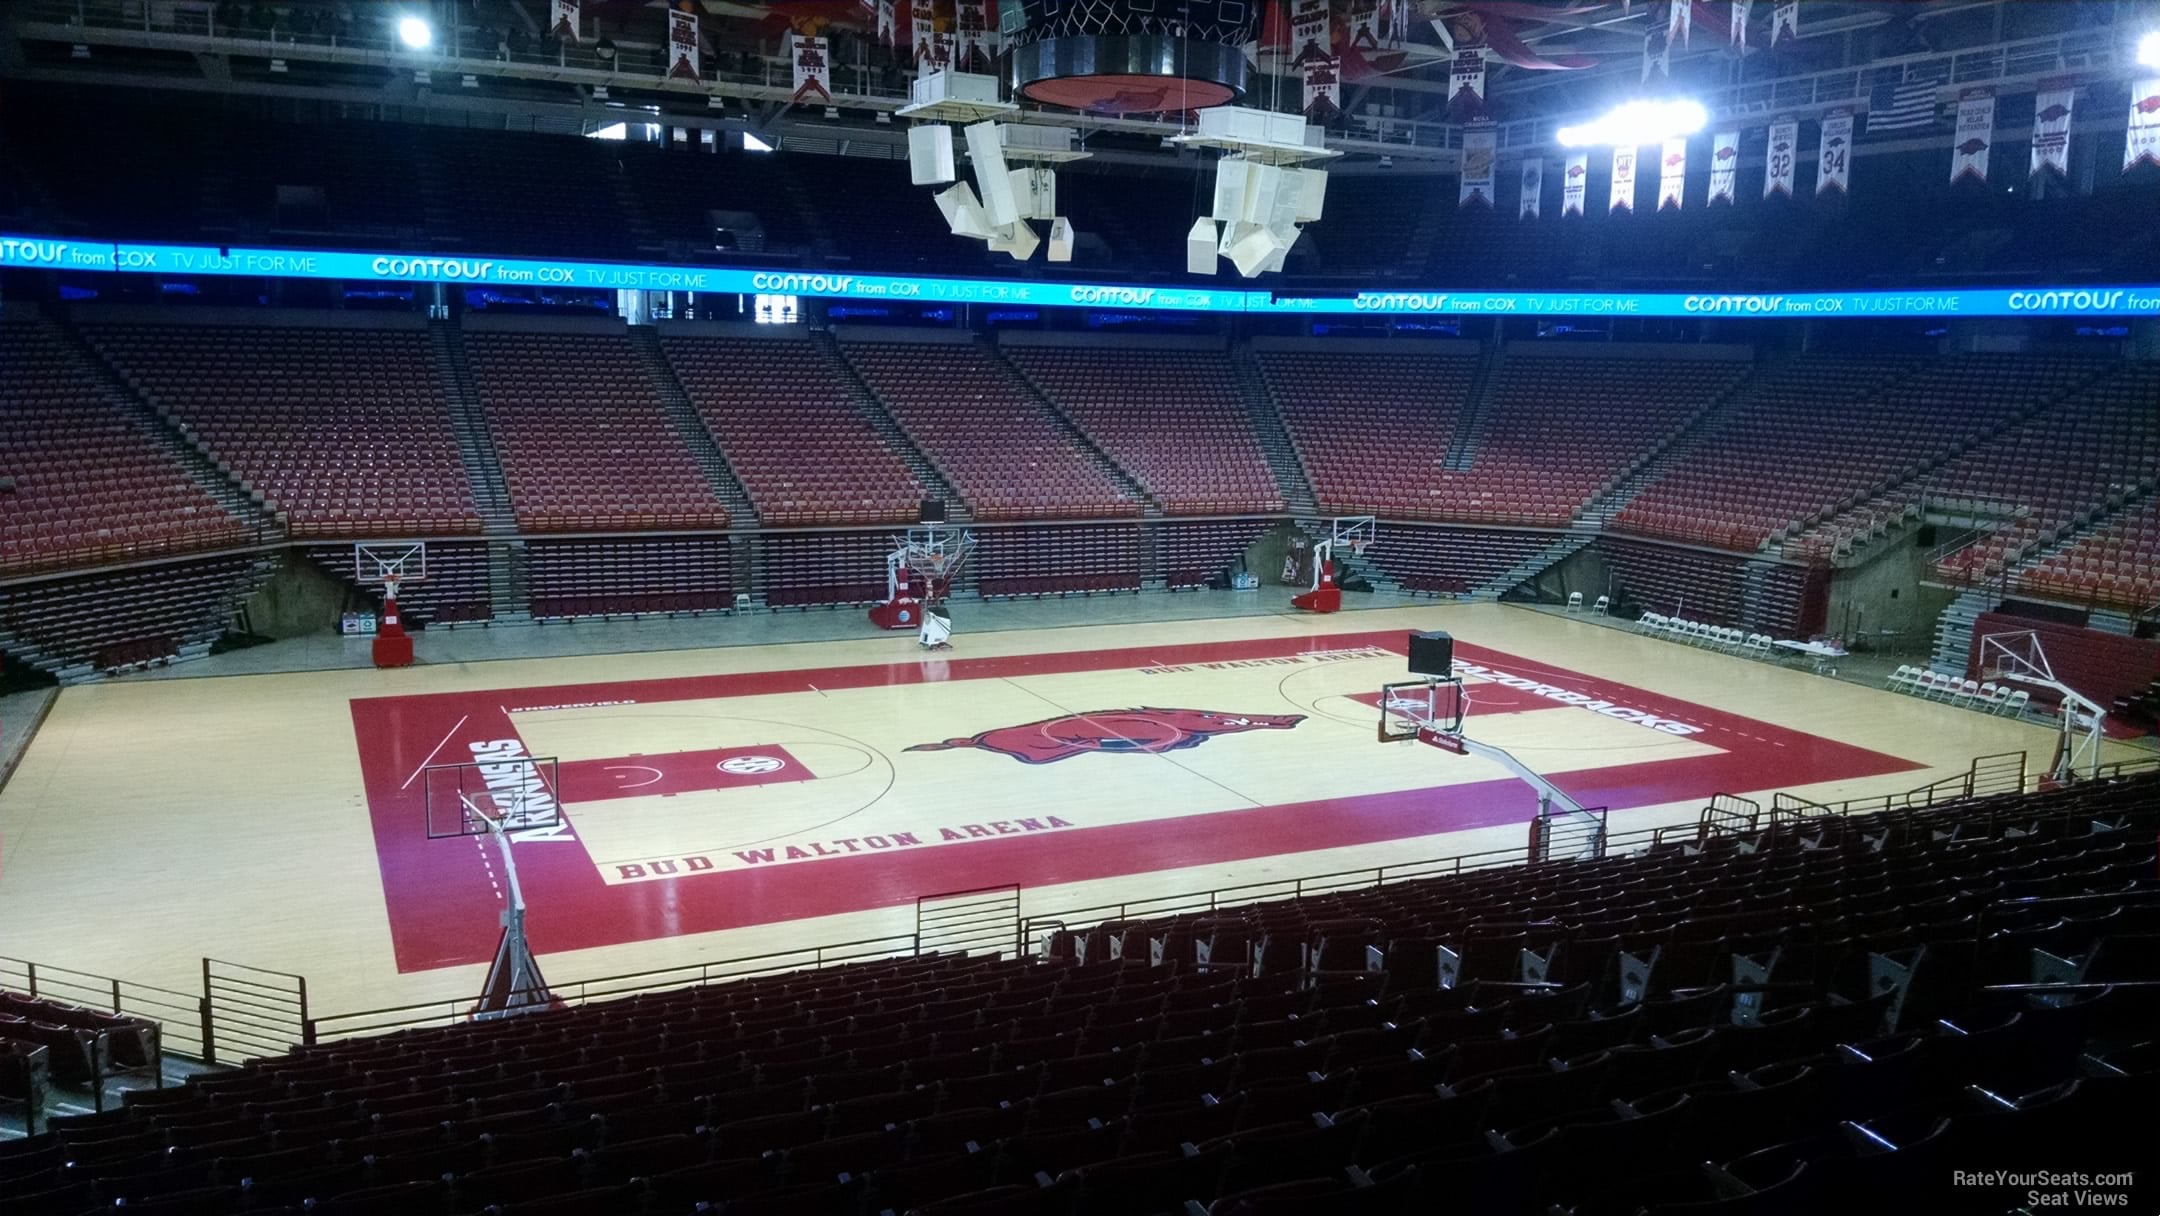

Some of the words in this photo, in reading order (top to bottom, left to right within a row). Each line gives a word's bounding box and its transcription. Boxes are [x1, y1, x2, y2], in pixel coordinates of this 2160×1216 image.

[1770, 154, 1791, 178] 32
[1823, 149, 1845, 174] 34
[71, 248, 106, 265] from
[111, 250, 157, 267] COX
[172, 252, 195, 269] TV
[199, 253, 242, 270] JUST
[248, 255, 285, 271] FOR
[290, 257, 317, 272] ME
[497, 265, 534, 281] from
[538, 267, 574, 283] COX
[586, 269, 606, 284] TV
[609, 271, 646, 286] JUST
[650, 272, 681, 287] FOR
[684, 273, 707, 288] ME
[856, 280, 886, 295] from
[889, 281, 920, 296] COX
[931, 284, 946, 297] TV
[949, 284, 980, 299] JUST
[982, 285, 1008, 299] FOR
[1011, 286, 1031, 300] ME
[1158, 293, 1183, 305] from
[1185, 295, 1212, 308] COX
[1451, 298, 1481, 311] from
[1484, 298, 1516, 311] COX
[1527, 298, 1545, 311] TV
[1548, 298, 1582, 312] JUST
[1584, 298, 1613, 312] FOR
[1616, 299, 1639, 312] ME
[1785, 299, 1812, 313] from
[1815, 298, 1844, 313] COX
[1852, 298, 1869, 312] TV
[1871, 297, 1904, 312] JUST
[1905, 297, 1935, 311] FOR
[1938, 296, 1959, 311] ME
[1198, 656, 1307, 671] WALTON
[615, 855, 714, 880] BUD
[731, 831, 924, 866] WALTON
[936, 814, 1075, 841] ARENA
